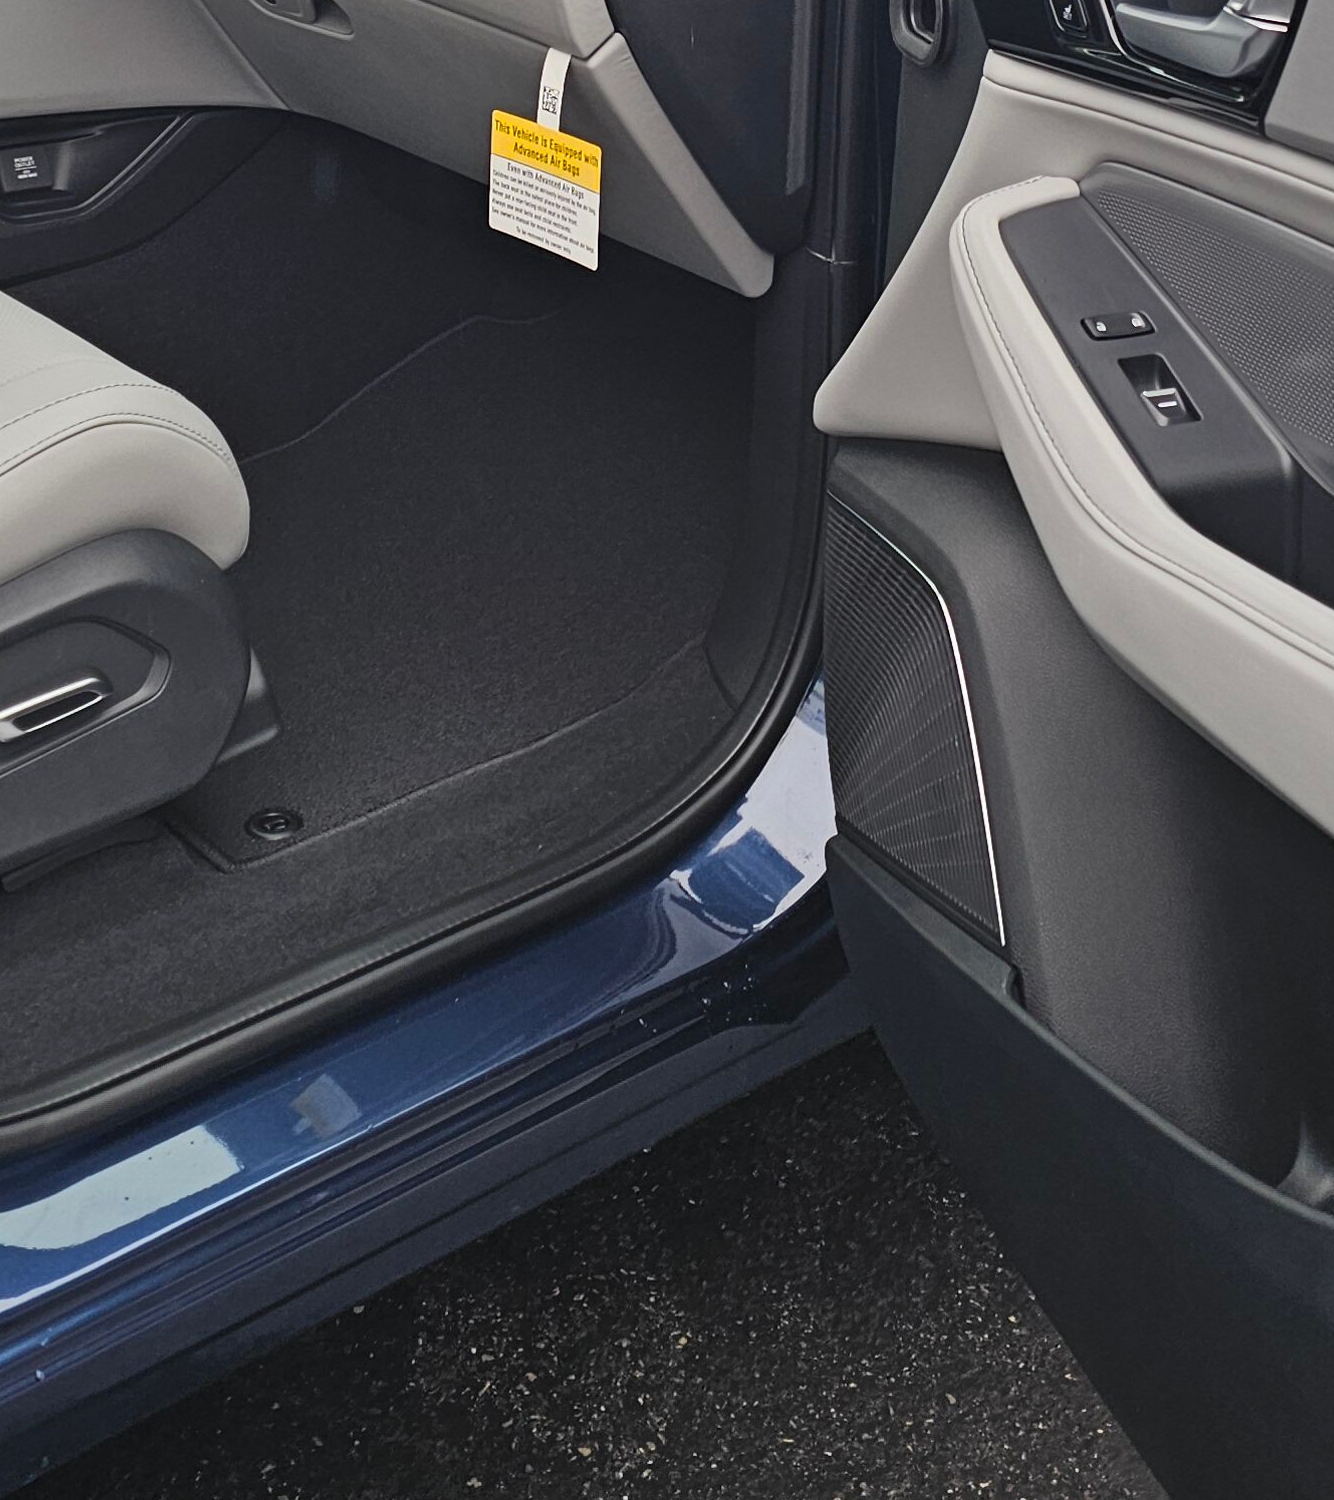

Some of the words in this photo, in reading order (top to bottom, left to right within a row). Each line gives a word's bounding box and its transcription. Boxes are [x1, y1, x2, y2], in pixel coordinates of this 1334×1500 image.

[495, 119, 509, 134] This
[512, 125, 539, 144] Vehicle
[549, 138, 582, 161] Equipped
[584, 152, 598, 167] with
[513, 141, 547, 163] Advanced
[549, 154, 560, 168] Air
[562, 159, 579, 177] Bags
[507, 162, 520, 174] Even
[522, 167, 533, 178] with
[535, 172, 560, 189] Advanced
[561, 182, 569, 193] Air
[571, 186, 584, 200] Bags
